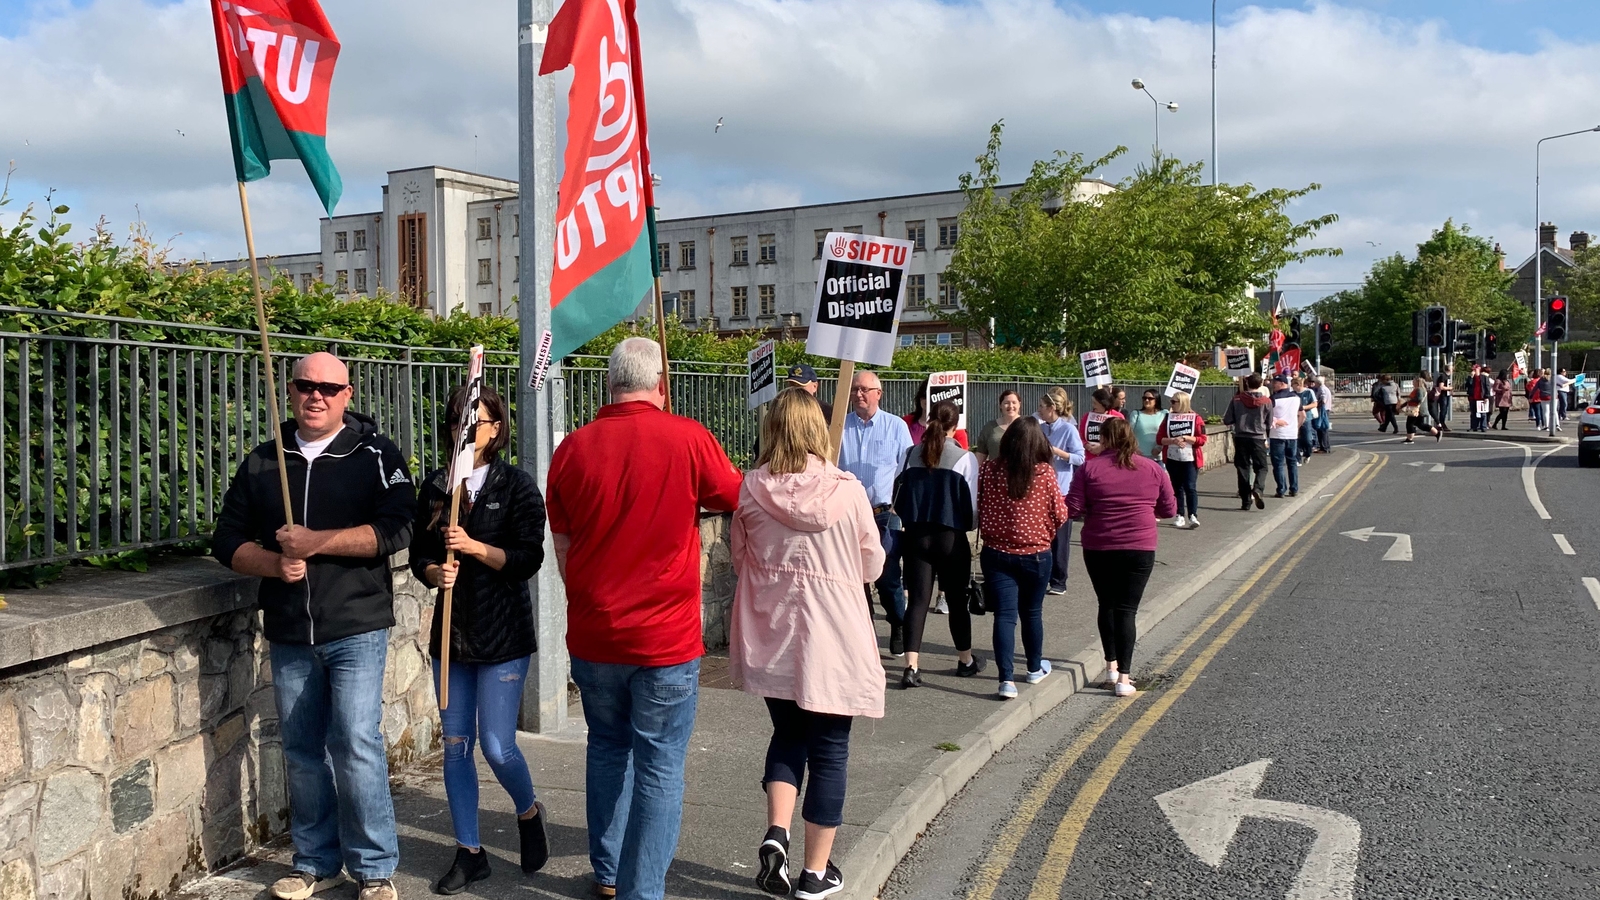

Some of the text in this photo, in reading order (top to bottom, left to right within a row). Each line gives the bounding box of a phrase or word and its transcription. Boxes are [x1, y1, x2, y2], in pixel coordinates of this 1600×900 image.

[847, 239, 908, 266] SIPTU
[826, 271, 891, 296] Official
[827, 296, 894, 320] Dispute
[530, 371, 540, 388] FREE
[535, 332, 552, 371] PALESTINE
[756, 342, 774, 360] SIPTU
[751, 356, 771, 380] Official
[753, 367, 772, 390] Dispute
[938, 374, 964, 385] SIPTU
[931, 386, 961, 403] Official
